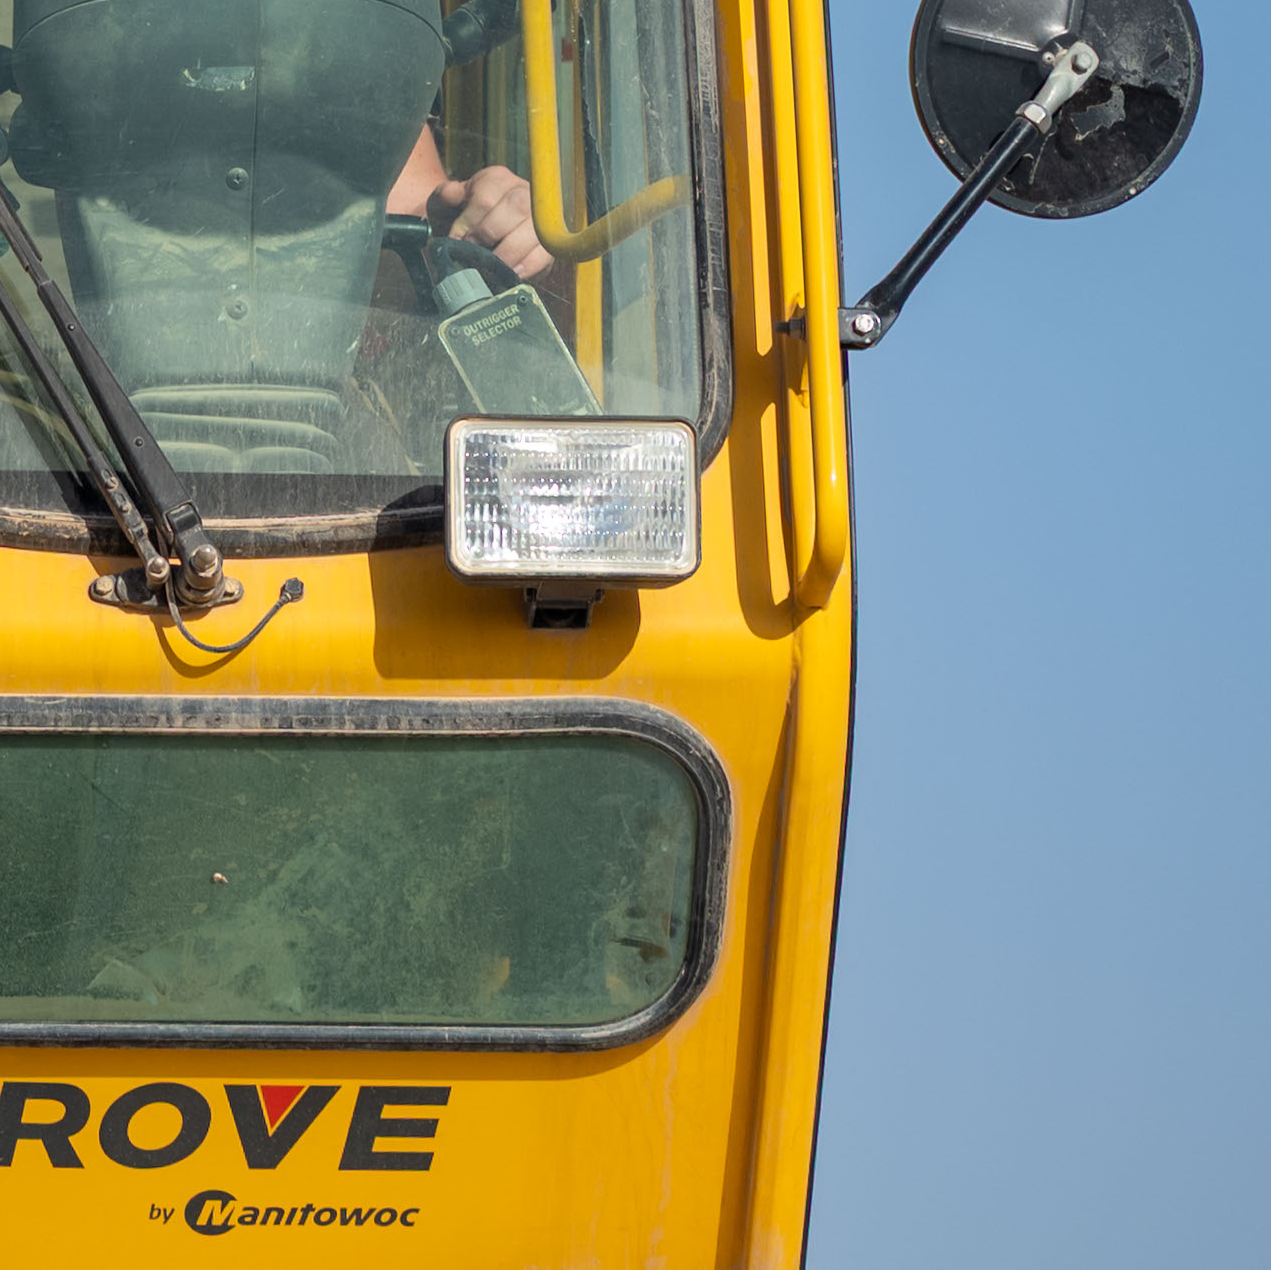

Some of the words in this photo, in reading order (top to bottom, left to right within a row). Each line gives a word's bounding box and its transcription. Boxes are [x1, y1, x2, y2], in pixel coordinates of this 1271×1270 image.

[463, 304, 520, 337] OUTRIGGER
[471, 315, 522, 346] SELECTOR
[148, 1203, 175, 1225] by
[185, 1192, 420, 1234] Manitowoc
